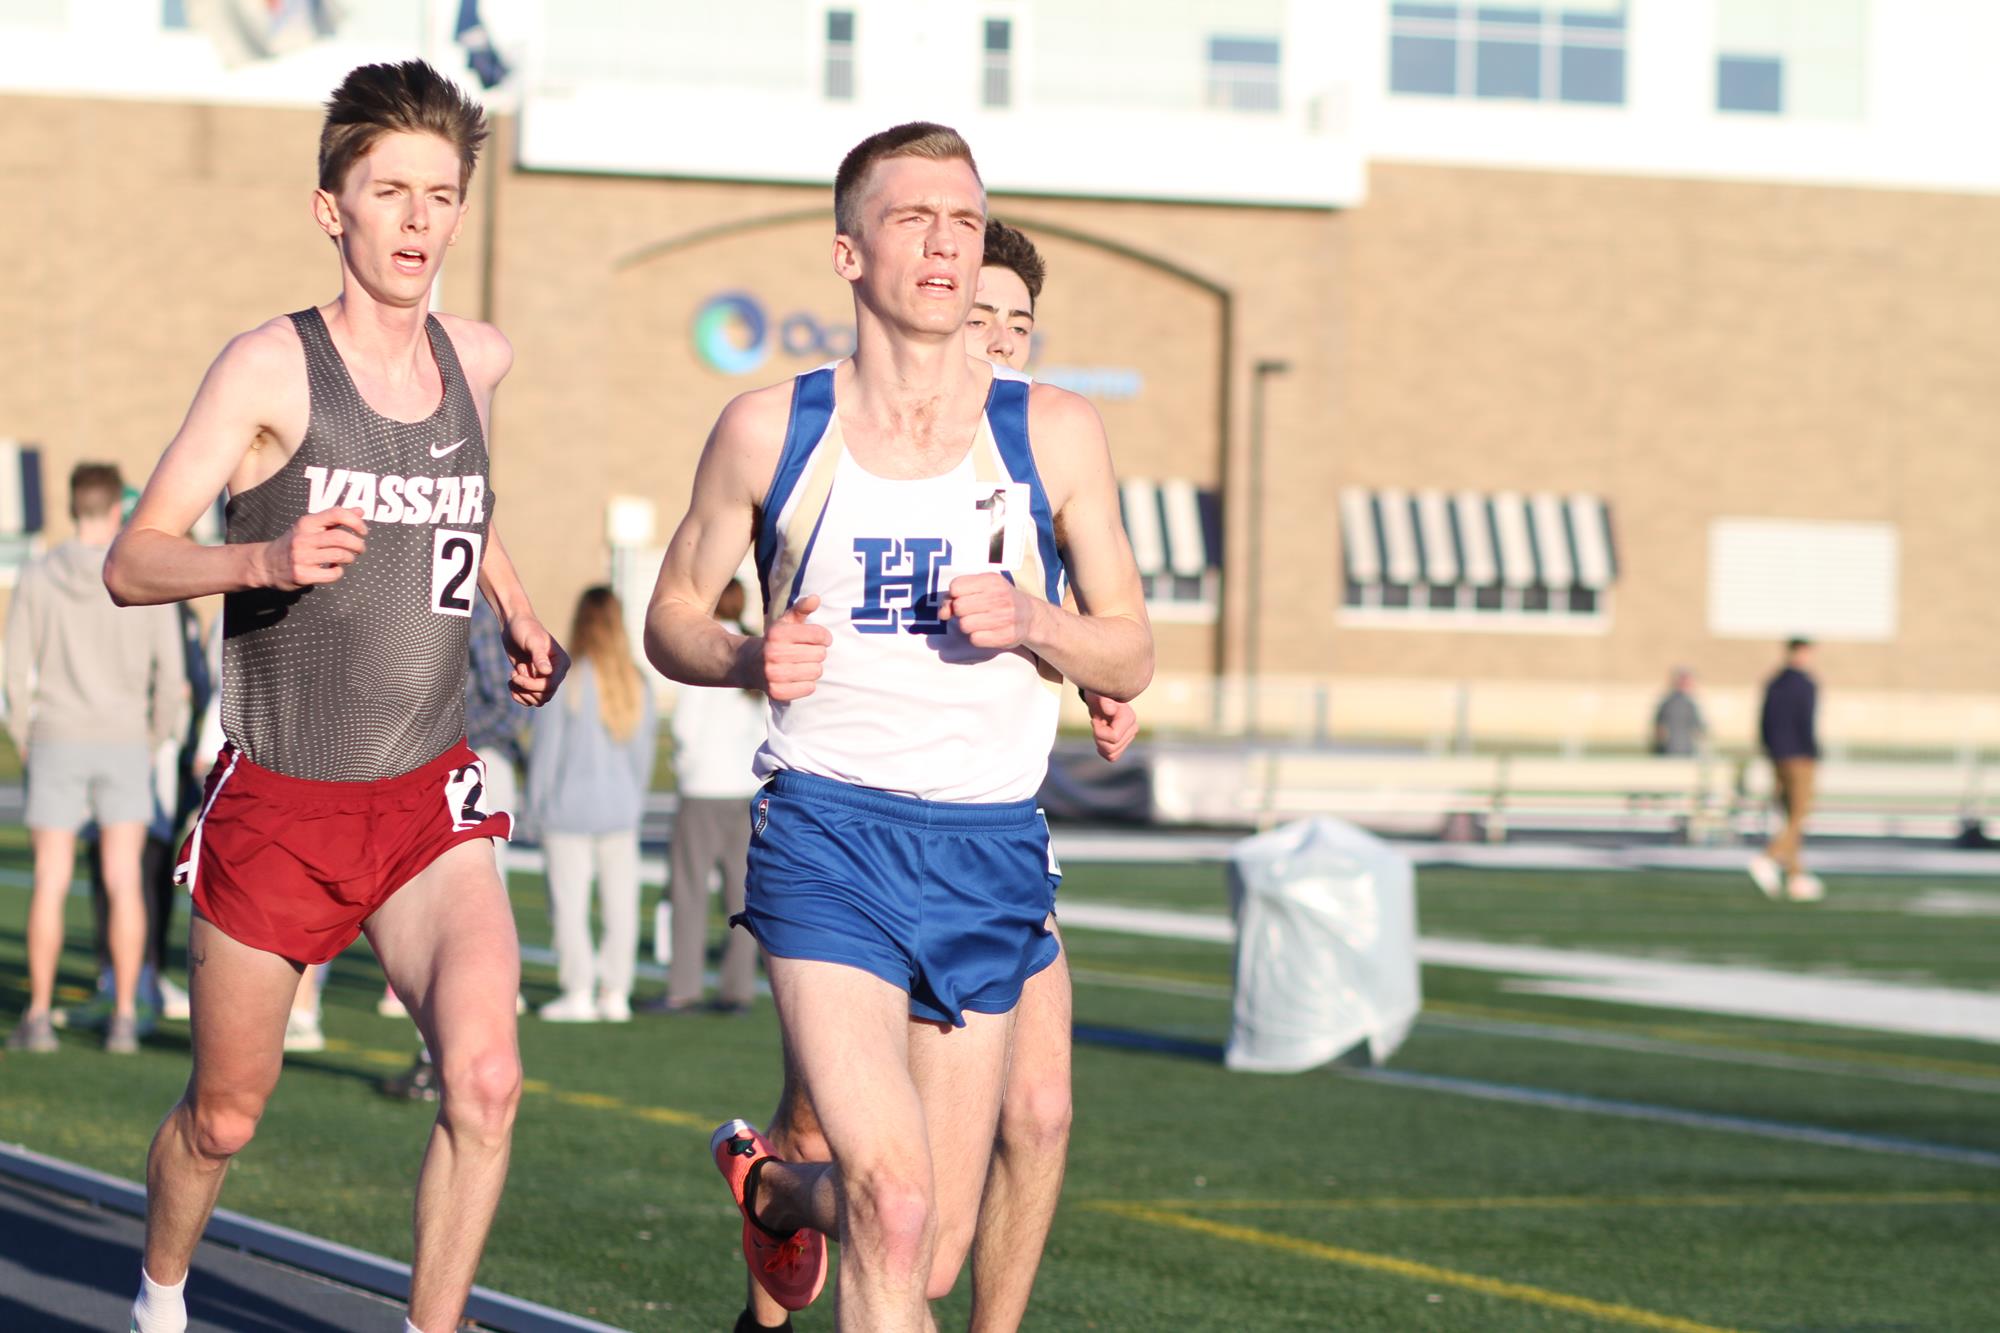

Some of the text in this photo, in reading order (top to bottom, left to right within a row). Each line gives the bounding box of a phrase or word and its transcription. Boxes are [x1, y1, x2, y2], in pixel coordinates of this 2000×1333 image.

[304, 466, 485, 525] VASSAR
[975, 489, 1006, 564] 1
[439, 537, 474, 611] 2
[850, 537, 952, 634] H
[453, 765, 487, 821] 2
